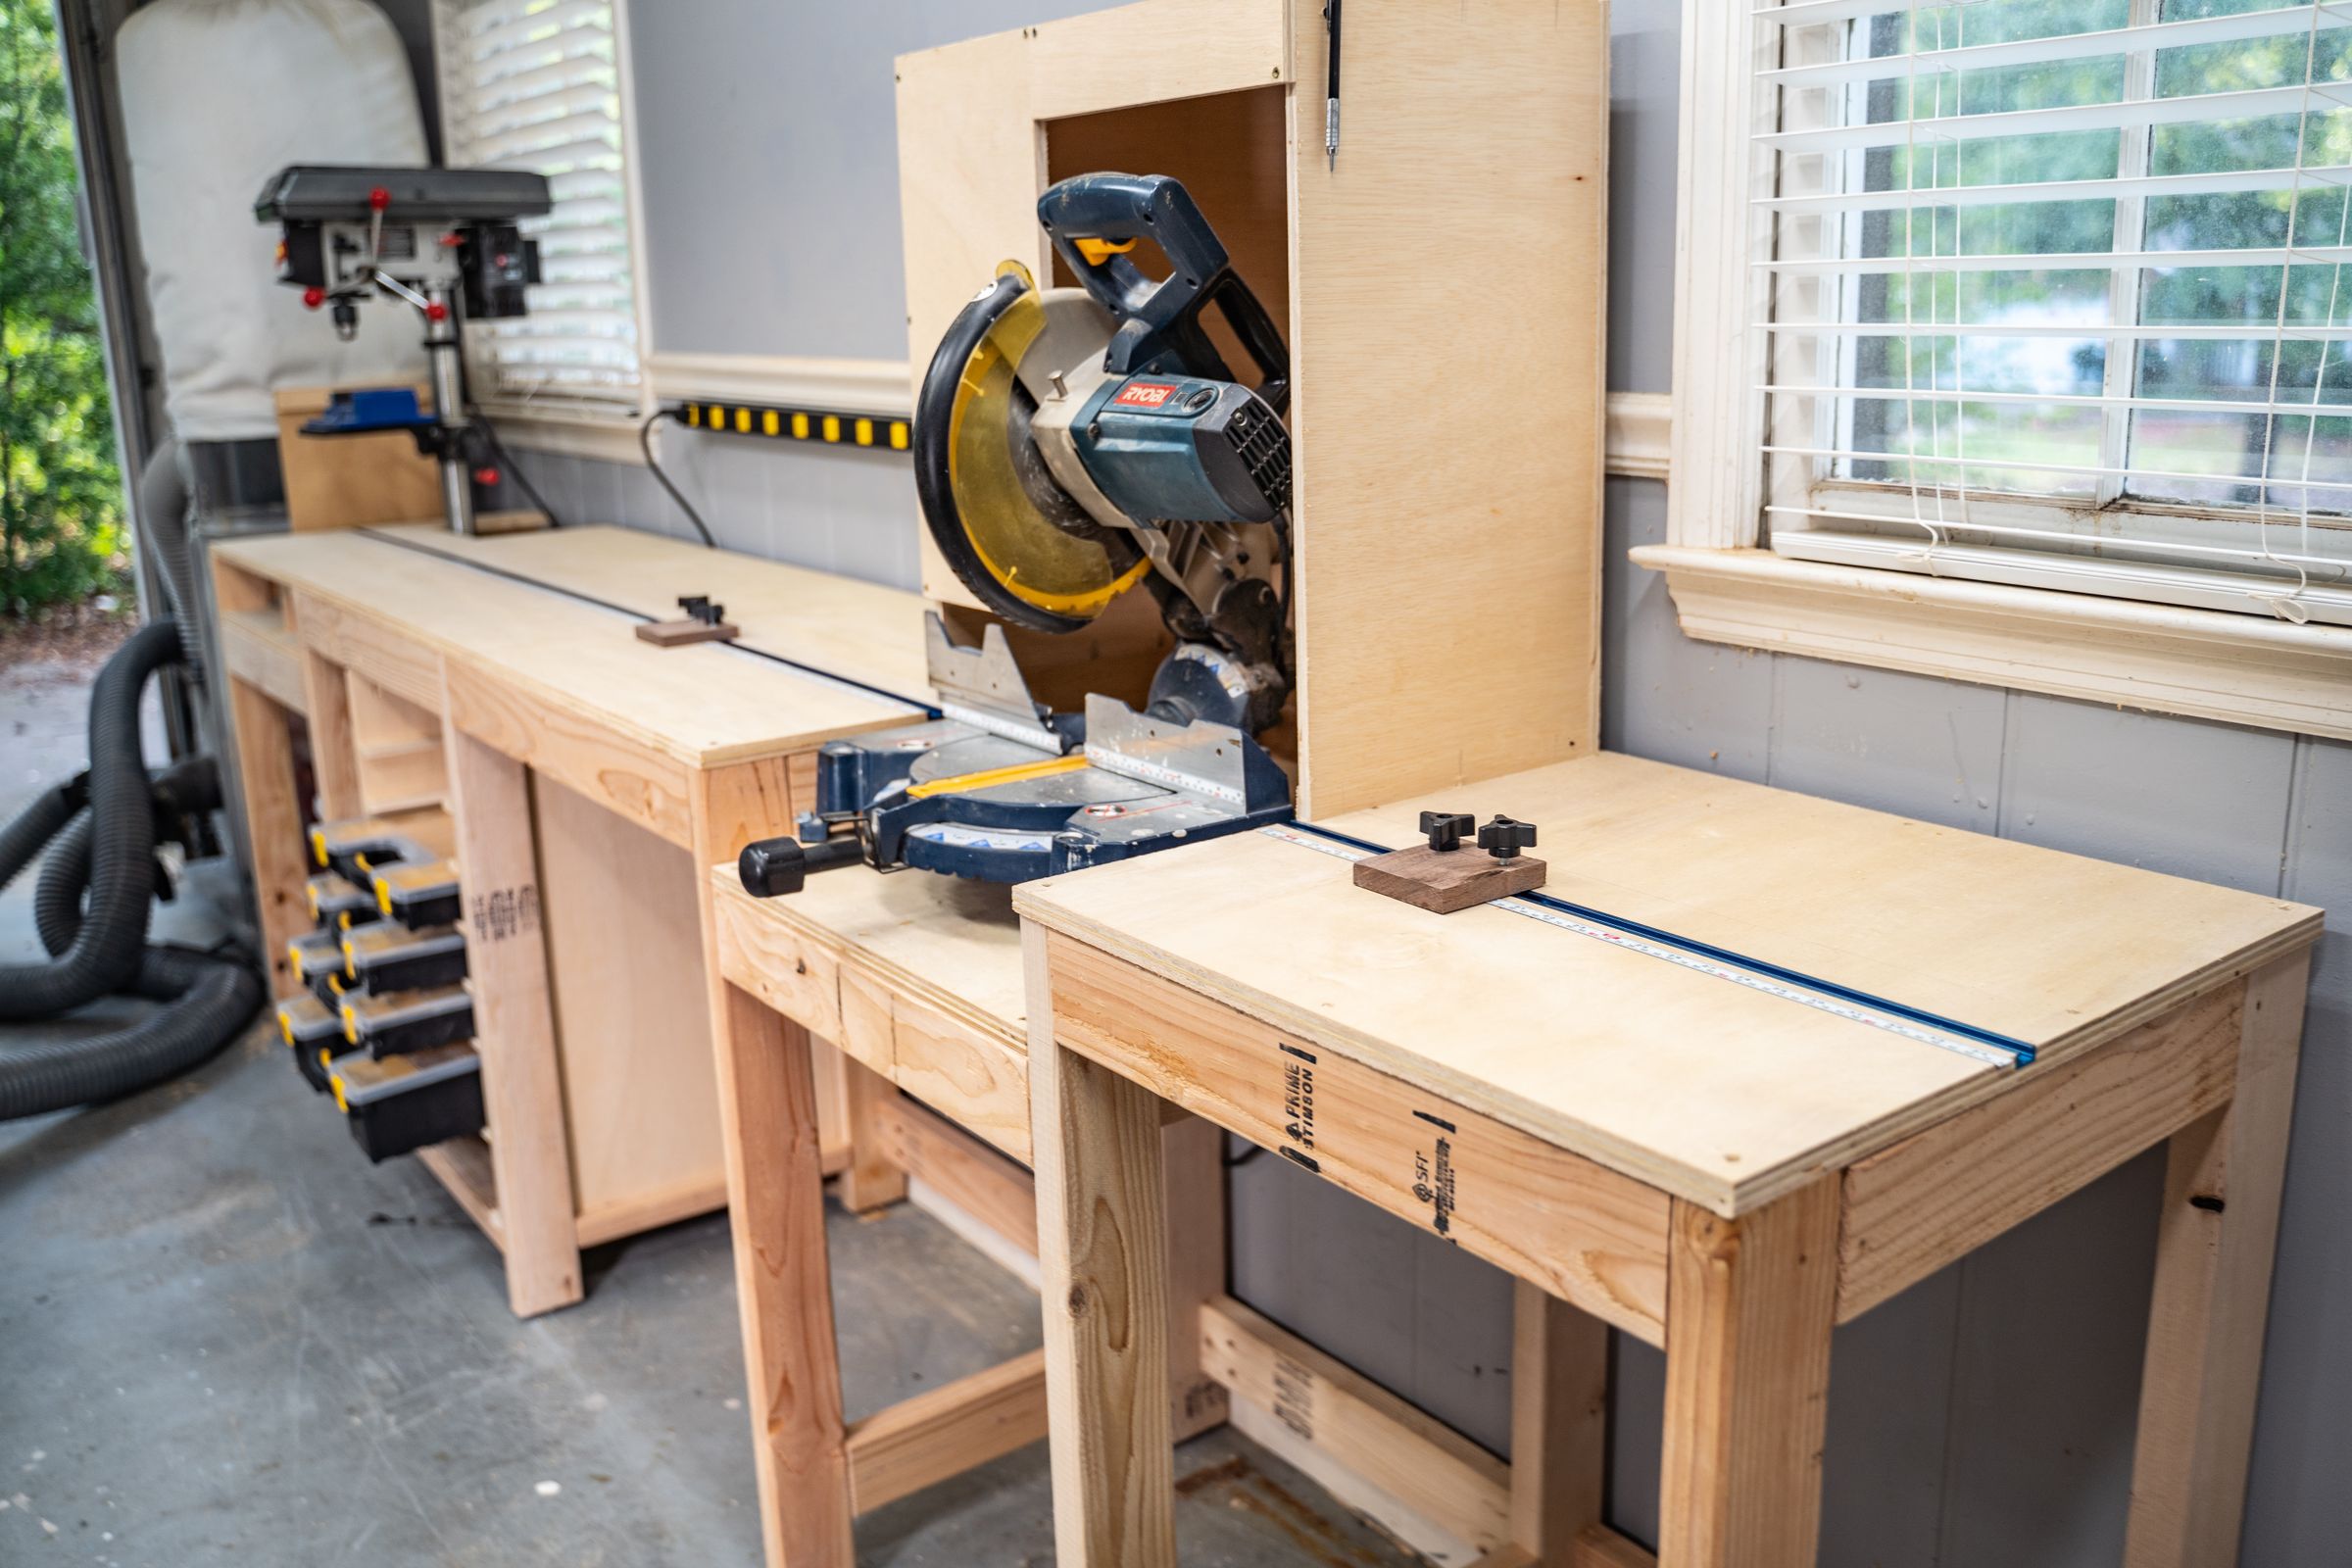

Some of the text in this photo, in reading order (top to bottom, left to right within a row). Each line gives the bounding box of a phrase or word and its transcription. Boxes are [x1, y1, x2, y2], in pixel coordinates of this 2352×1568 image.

[1122, 386, 1170, 403] RYOBI
[1284, 1061, 1300, 1119] PRIME
[1415, 1153, 1429, 1183] SFI
